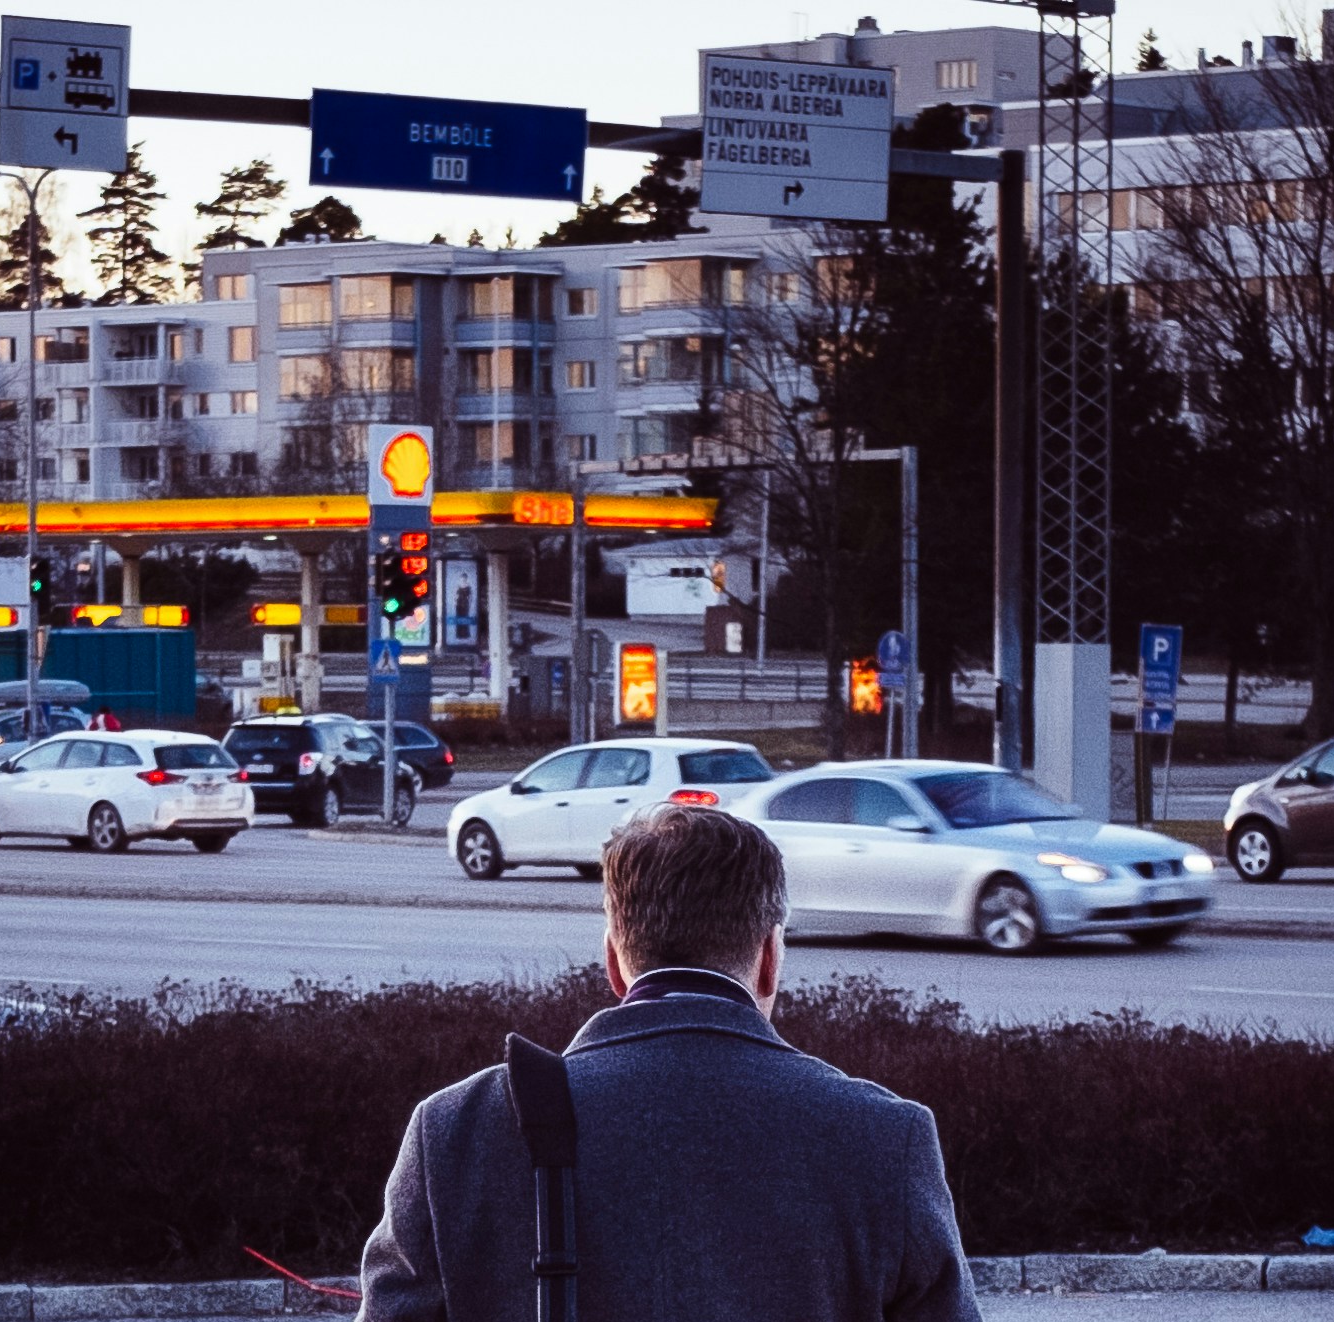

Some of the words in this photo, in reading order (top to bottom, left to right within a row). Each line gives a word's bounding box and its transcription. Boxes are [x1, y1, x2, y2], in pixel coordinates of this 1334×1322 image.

[710, 66, 889, 99] POHJOIS-LEPPÄVAARA
[709, 89, 764, 111] NORRA
[771, 94, 844, 117] ALBERGA
[409, 122, 493, 148] BEMBÖLE
[708, 118, 809, 143] LINTUVAARA
[707, 139, 811, 168] FÅGELBERGA
[436, 159, 464, 180] 110
[1152, 637, 1169, 662] P
